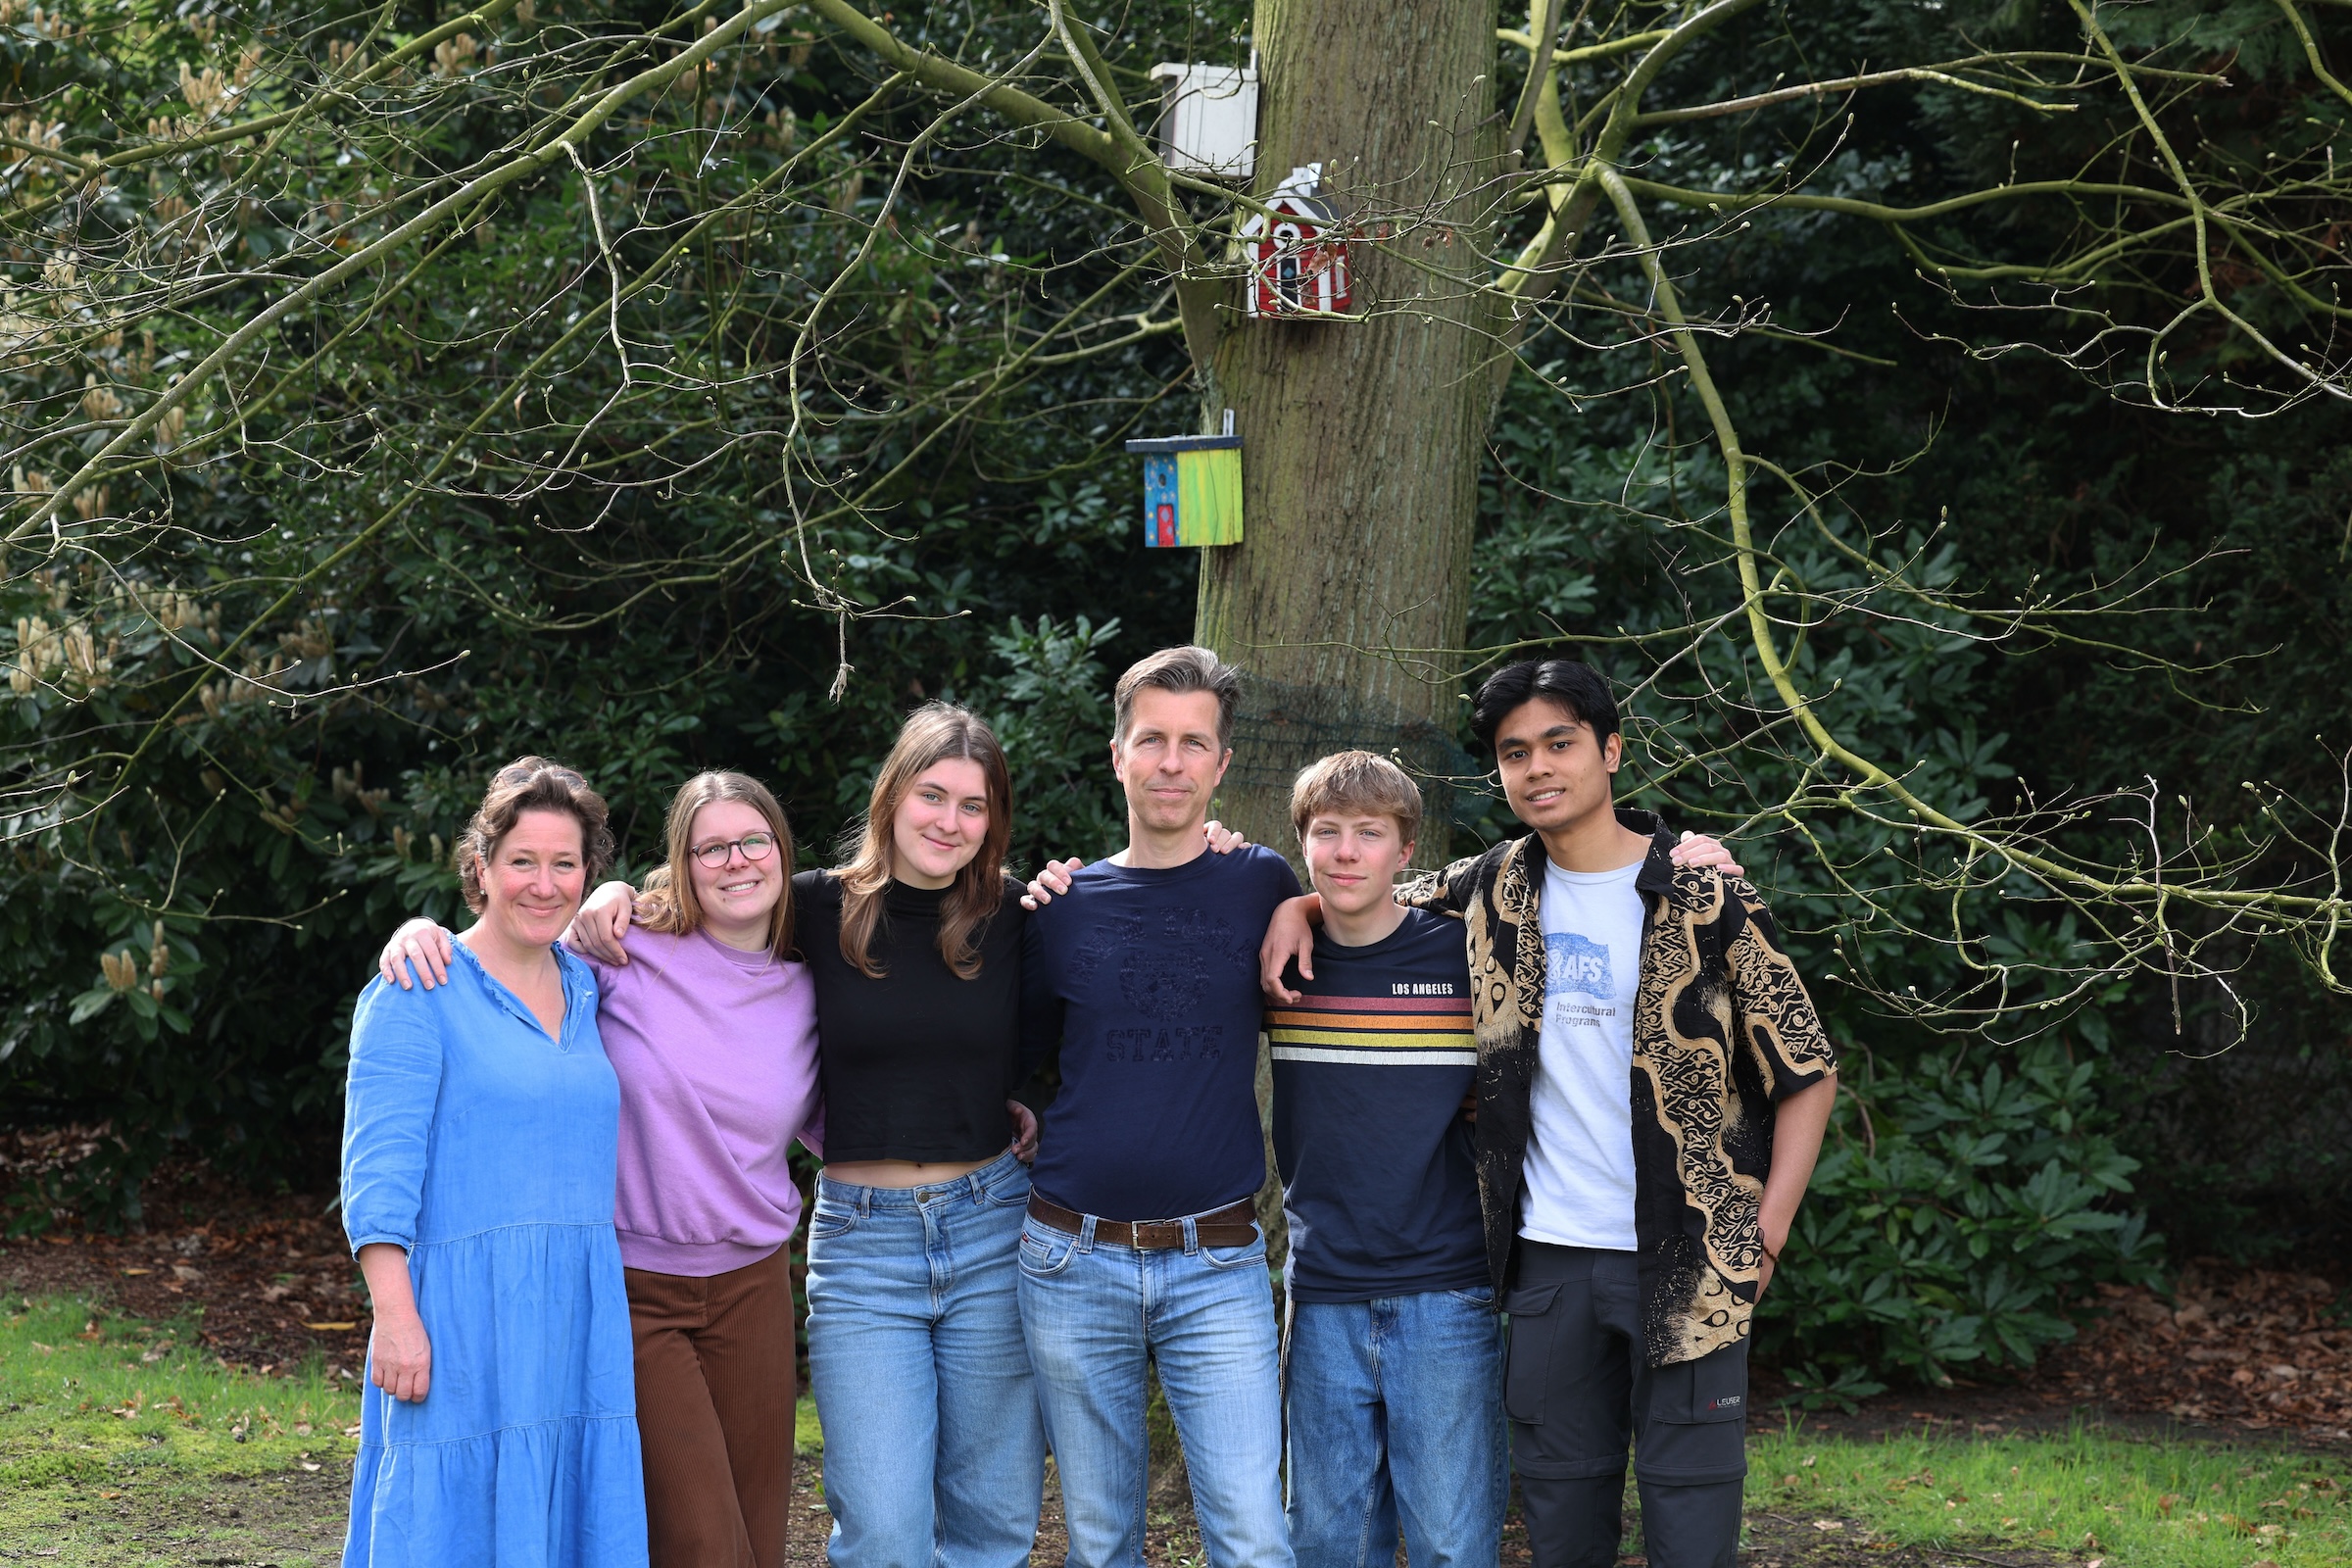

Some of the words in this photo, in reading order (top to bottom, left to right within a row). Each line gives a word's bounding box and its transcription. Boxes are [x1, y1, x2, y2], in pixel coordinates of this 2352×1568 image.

[1067, 907, 1147, 984] NEW
[1158, 906, 1255, 977] YORK
[1562, 954, 1603, 983] AFS
[1392, 983, 1410, 995] LOS
[1412, 983, 1453, 995] ANGELES
[1556, 1002, 1616, 1016] Intercultural
[1106, 1025, 1223, 1062] STATE
[1716, 1396, 1740, 1406] LEUSER
